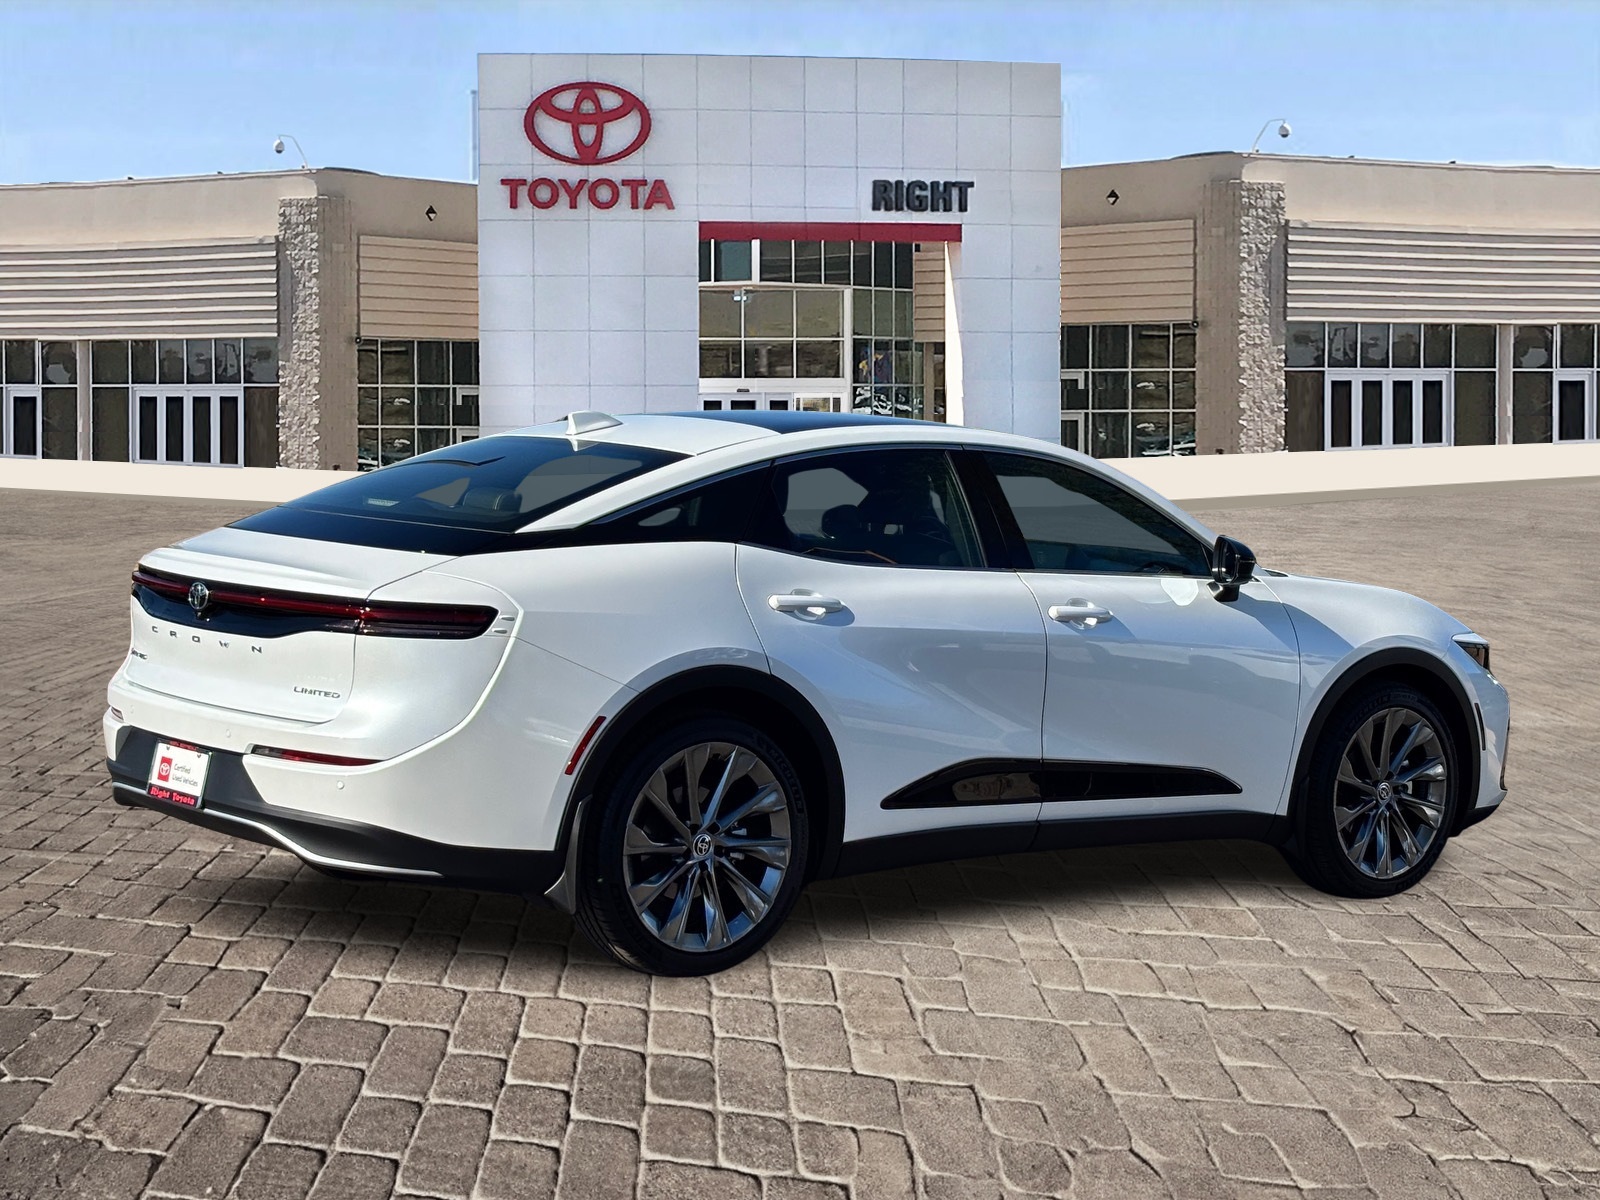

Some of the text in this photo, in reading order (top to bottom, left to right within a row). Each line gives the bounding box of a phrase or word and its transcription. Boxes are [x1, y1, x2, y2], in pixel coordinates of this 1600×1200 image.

[500, 178, 675, 210] TOYOTA
[871, 179, 975, 213] RIGHT
[151, 625, 262, 653] CROWN
[293, 686, 341, 699] LIMITED
[150, 786, 195, 805] Right Toyota
